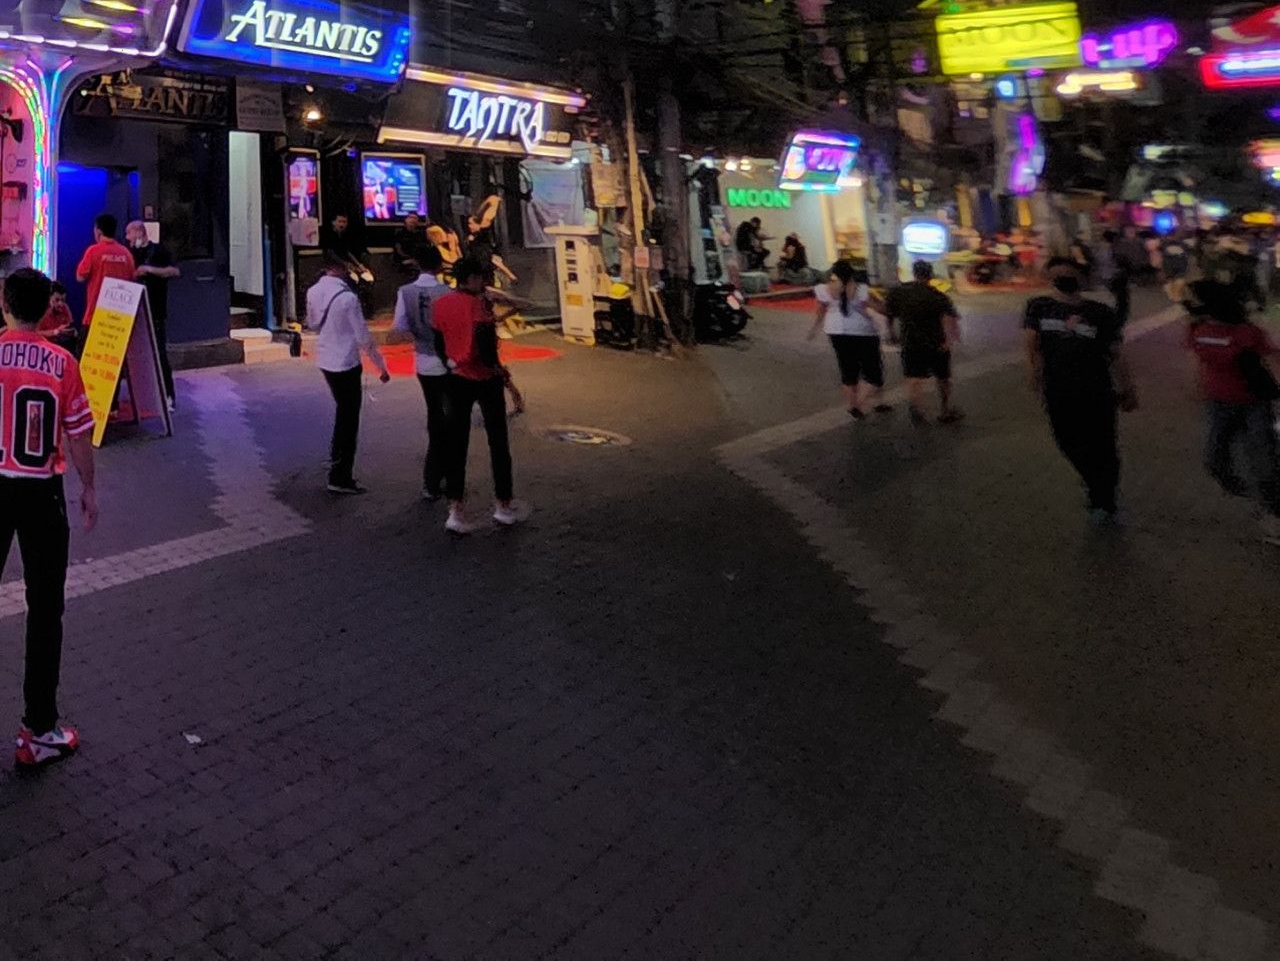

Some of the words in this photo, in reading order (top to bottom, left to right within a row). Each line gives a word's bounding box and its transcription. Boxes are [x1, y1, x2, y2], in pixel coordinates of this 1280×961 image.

[225, 0, 382, 58] ATLANTIS
[447, 87, 545, 154] TANTRA
[727, 187, 792, 209] MOON
